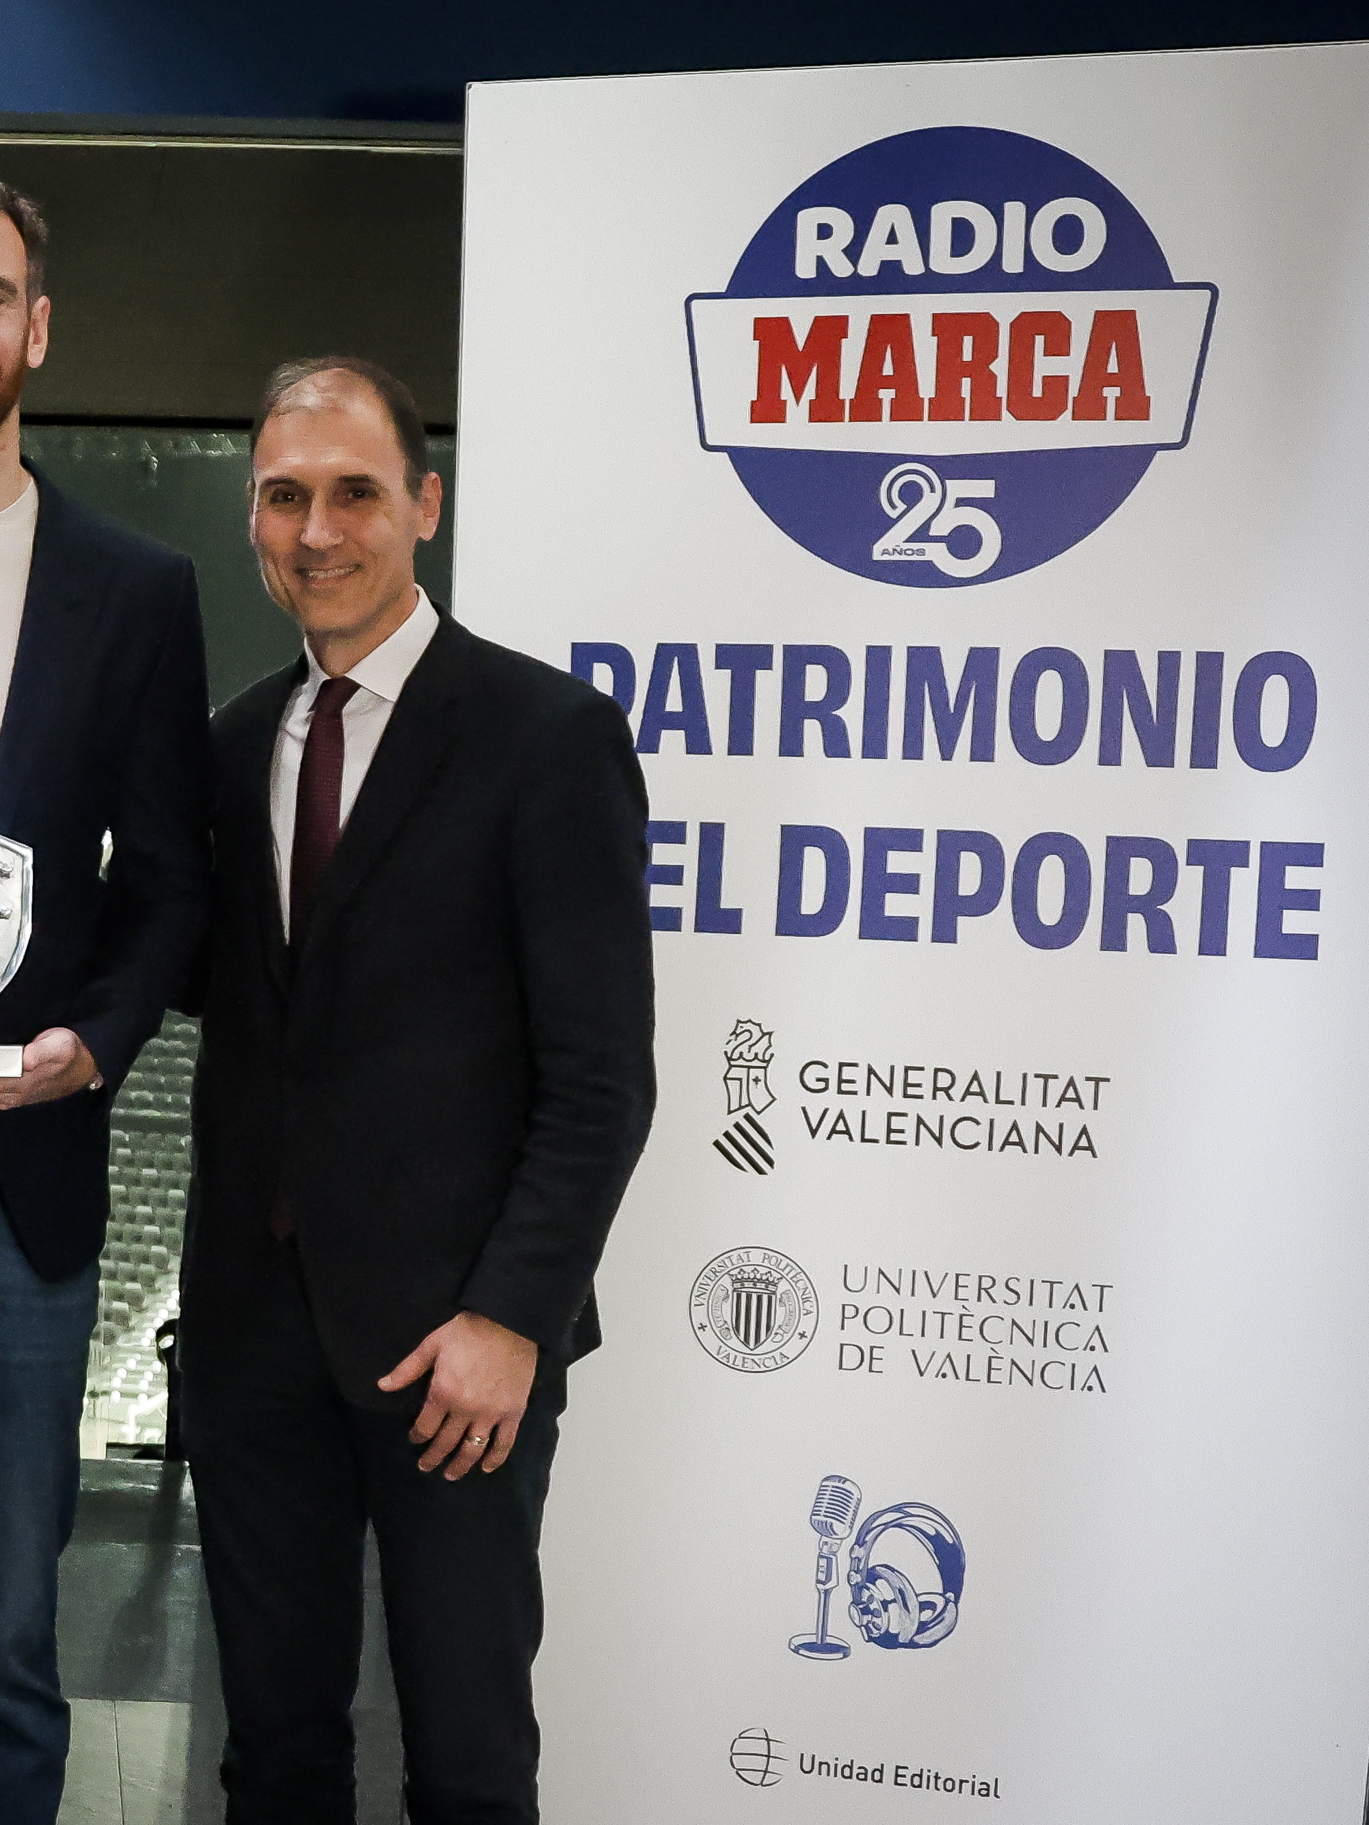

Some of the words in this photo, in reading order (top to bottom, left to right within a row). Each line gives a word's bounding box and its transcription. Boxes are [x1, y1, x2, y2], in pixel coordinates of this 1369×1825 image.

[794, 197, 1108, 279] RADIO
[750, 309, 1152, 424] MARCA
[872, 462, 1002, 579] 25
[880, 544, 927, 557] AÑOS
[775, 823, 1326, 961] DEPORTE
[798, 1060, 1111, 1111] GENERALITAT
[800, 1106, 1098, 1158] VALENCIANA
[842, 1264, 1114, 1312] UNIVERSITAT
[839, 1303, 1109, 1353] POLITÈCNICA
[715, 1345, 791, 1370] VALENCIA
[838, 1343, 885, 1373] DE
[910, 1347, 1107, 1393] VALÈNCIA
[799, 1752, 885, 1784] Unidad
[893, 1765, 1000, 1799] Editorial
